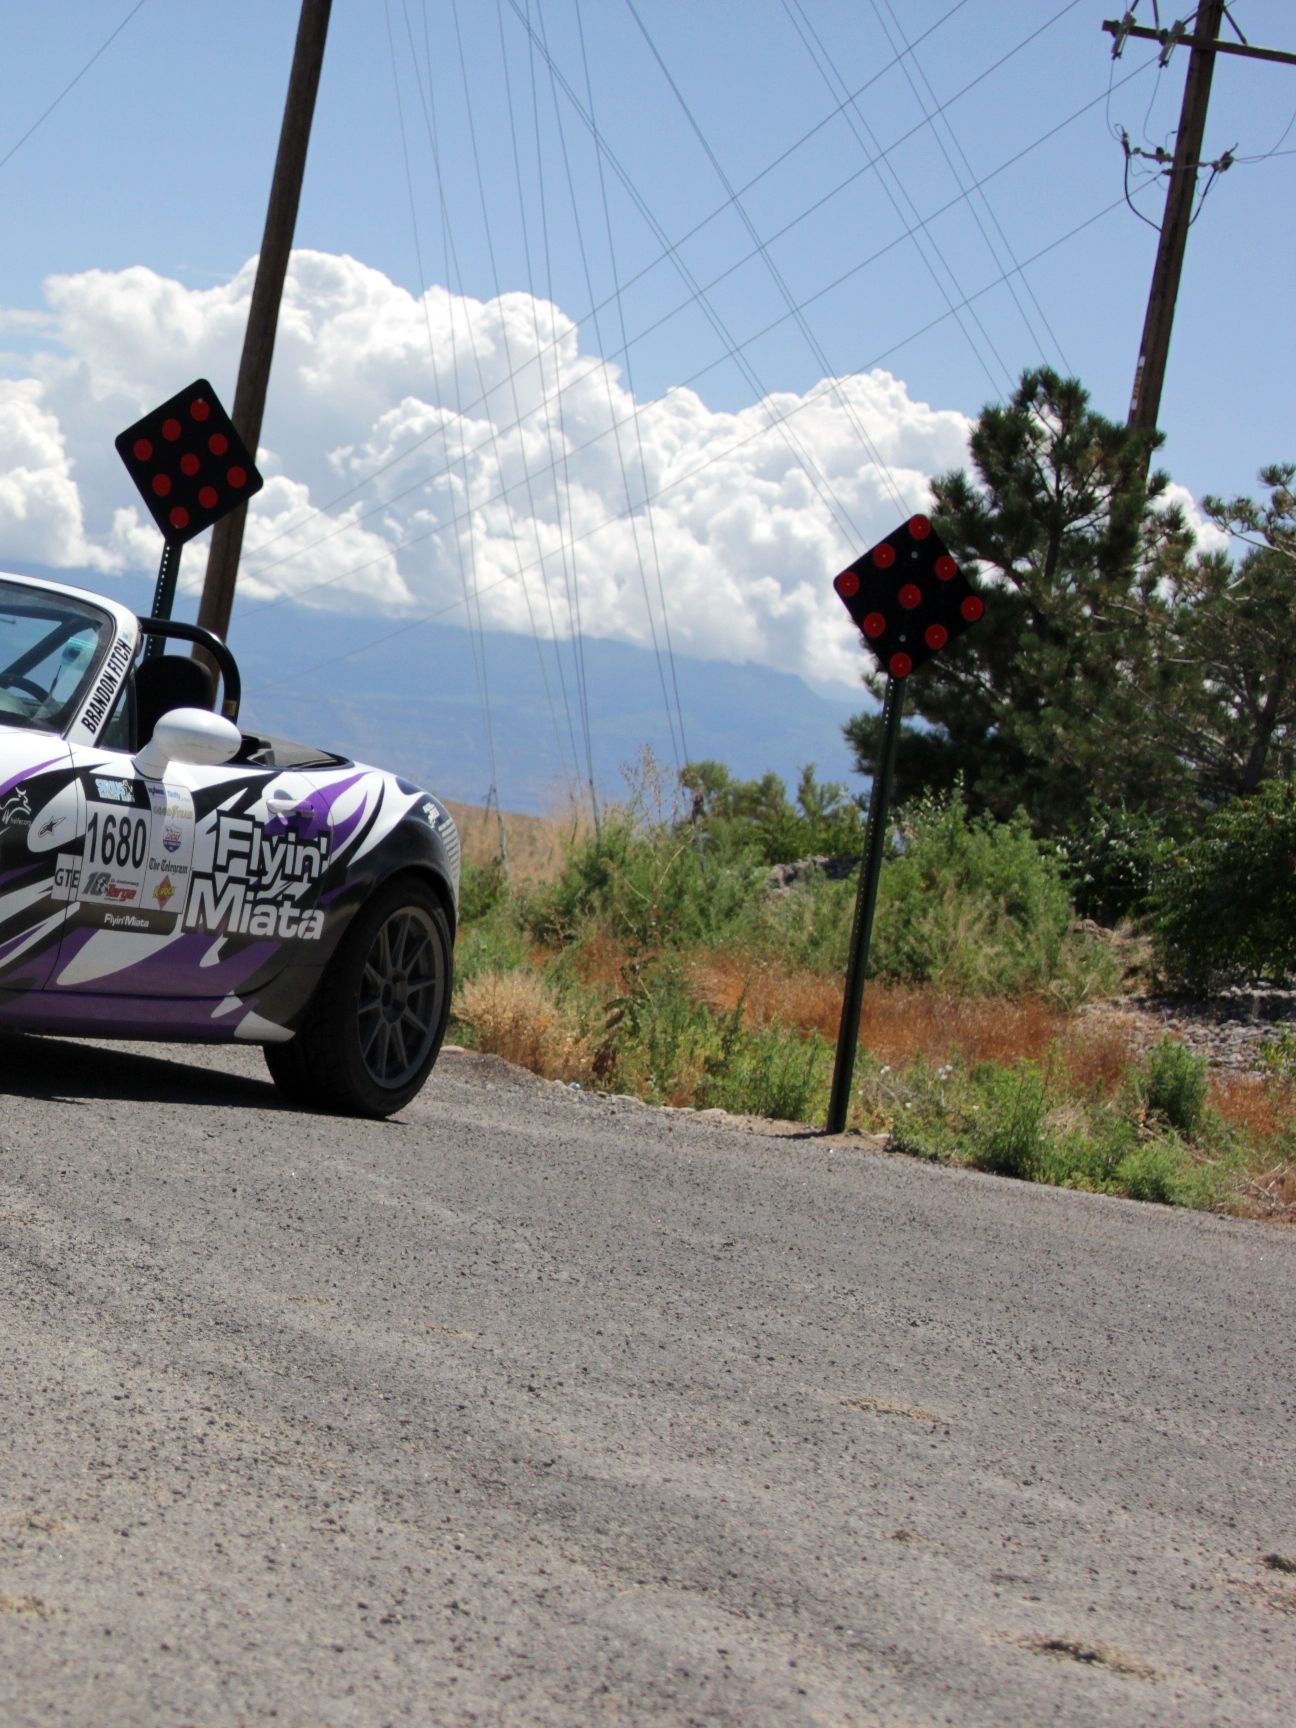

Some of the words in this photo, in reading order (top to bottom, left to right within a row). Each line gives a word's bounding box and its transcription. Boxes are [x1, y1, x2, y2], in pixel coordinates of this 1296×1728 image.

[81, 671, 118, 735] BRANDON
[107, 638, 132, 678] FITCH
[87, 812, 147, 869] 1680
[216, 815, 328, 885] Flyin'
[54, 868, 81, 888] GTE
[185, 877, 325, 940] Miata
